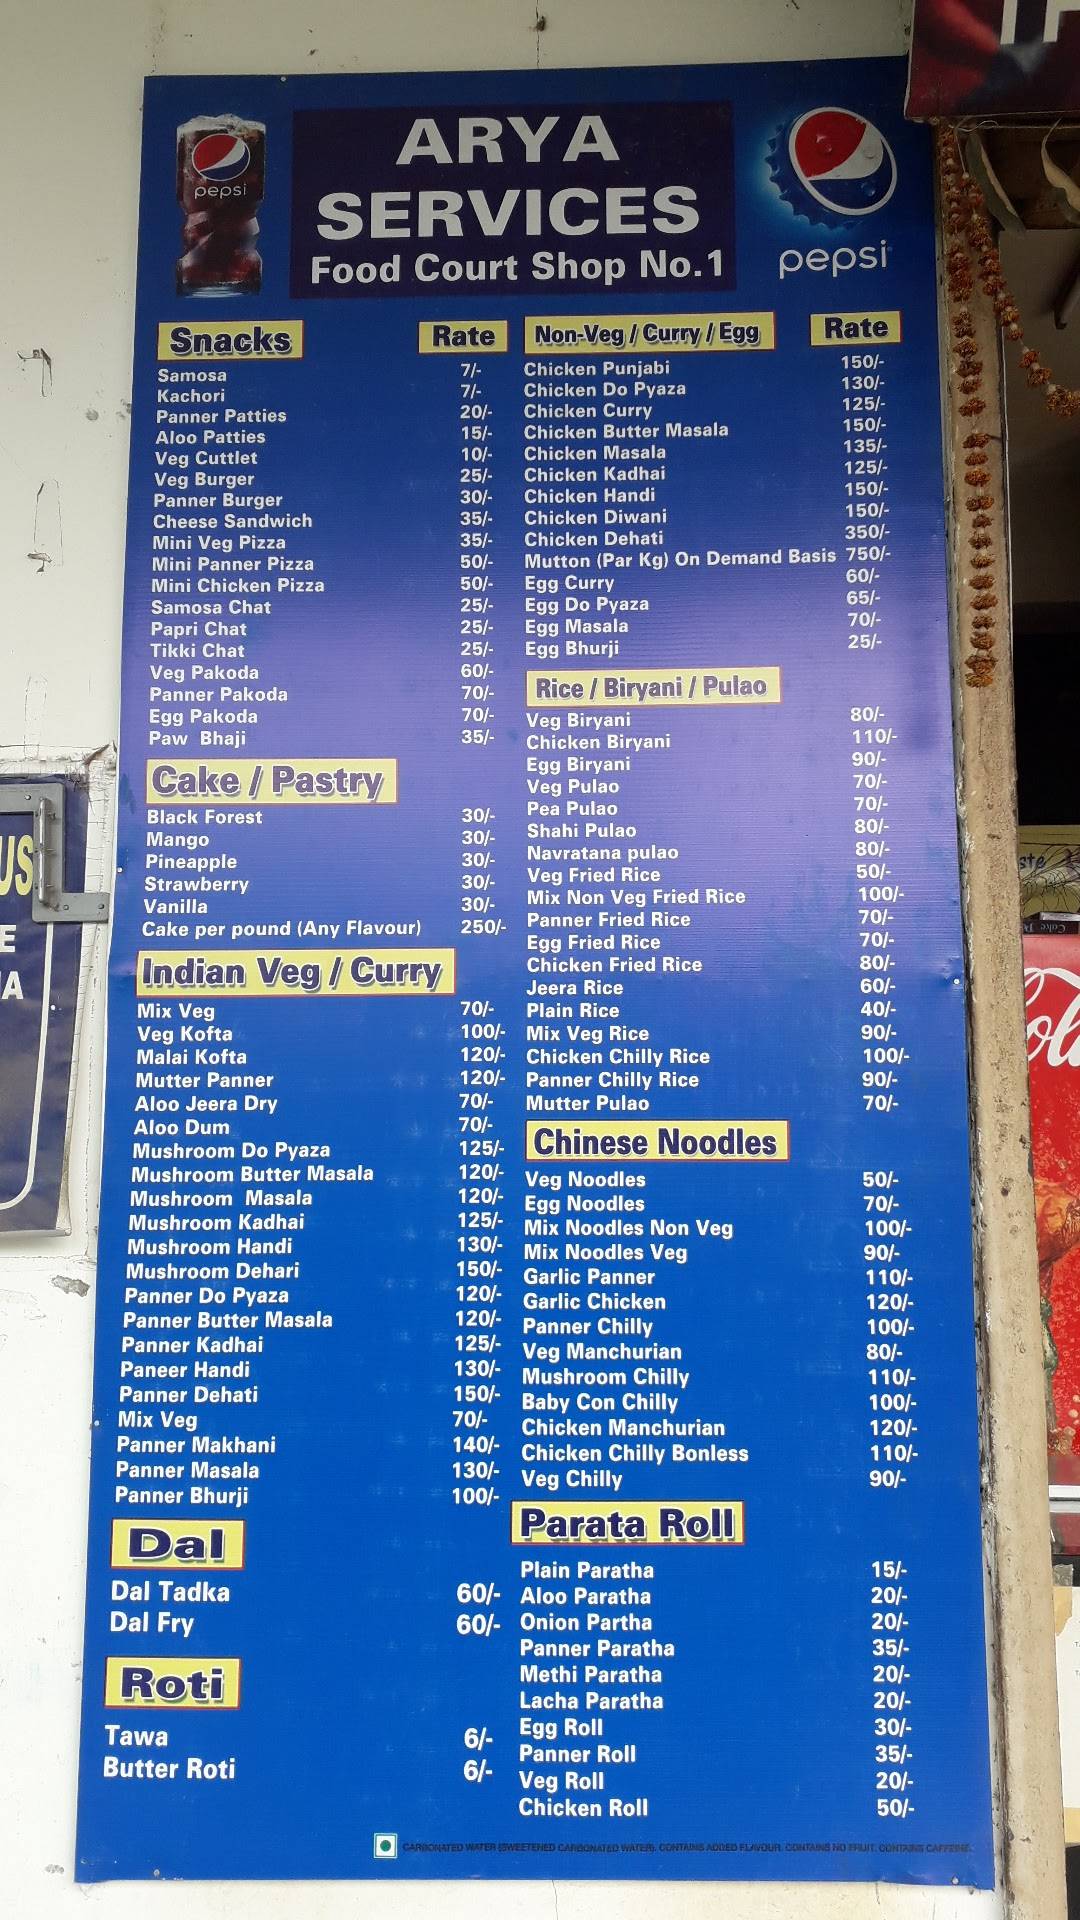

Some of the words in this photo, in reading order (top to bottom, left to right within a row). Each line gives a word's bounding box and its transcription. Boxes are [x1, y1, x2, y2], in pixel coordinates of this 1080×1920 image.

[396, 115, 620, 165] ARYA
[194, 183, 247, 199] pepsi
[317, 185, 700, 240] SERVICES
[312, 256, 400, 284] Food
[415, 253, 518, 282] Court
[532, 251, 625, 286] Shop
[640, 249, 723, 278] No.1
[779, 240, 887, 279] pepsi
[432, 325, 496, 349] Rate
[535, 325, 624, 347] Non-Veg
[643, 322, 700, 346] Curry
[719, 321, 760, 345] Egg
[824, 317, 889, 340] Rate
[170, 326, 292, 354] Snacks
[157, 368, 226, 382] Samosa
[460, 362, 481, 378] 7/-
[155, 430, 196, 444] Aloo
[203, 429, 265, 443] Patties
[461, 425, 492, 441] 15/-
[523, 424, 596, 439] Chicken
[603, 423, 659, 438] Butter
[665, 421, 728, 437] Masala
[843, 416, 886, 432] 150/-
[153, 514, 217, 528] Cheese
[224, 512, 312, 528] Sandwich
[460, 510, 492, 526] 35/-
[524, 510, 597, 525] Chicken
[604, 508, 666, 523] Diwani
[845, 502, 889, 518] 150/-
[524, 553, 590, 568] Mutton
[596, 552, 632, 568] (Par
[639, 551, 668, 570] Kg)
[674, 551, 699, 566] On
[706, 549, 781, 565] Demand
[788, 548, 836, 563] Basis
[845, 545, 890, 561] 750/-
[151, 578, 190, 592] Mini
[197, 577, 270, 592] Chicken
[277, 577, 324, 592] Pizza
[460, 575, 493, 591] 50/-
[149, 664, 184, 683] Veg
[191, 664, 258, 679] Pakoda
[460, 663, 493, 679] 60/-
[536, 678, 584, 699] Rice
[604, 676, 682, 702] Biryani
[704, 676, 767, 696] Pulao
[149, 730, 188, 745] Paw
[200, 730, 245, 748] Bhaji
[461, 728, 494, 745] 35/-
[526, 734, 600, 749] Chicken
[607, 733, 670, 751] Biryani
[852, 727, 897, 744] 110/-
[151, 765, 240, 795] Cake
[272, 765, 383, 801] Pastry
[146, 831, 209, 850] Mango
[461, 829, 495, 846] 30/-
[527, 845, 621, 860] Navratana
[627, 844, 678, 863] pulao
[855, 840, 890, 857] 80/-
[141, 920, 188, 936] Cake
[194, 924, 225, 939] per
[231, 920, 290, 939] pound
[297, 920, 340, 938] (Any
[346, 919, 420, 936] Flavour)
[460, 918, 506, 935] 250/-
[142, 958, 246, 986] Indian
[257, 957, 321, 991] Veg
[350, 956, 442, 990] Curry
[0, 971, 24, 1000] A
[526, 1002, 572, 1018] Plain
[579, 1002, 619, 1017] Rice
[860, 1000, 896, 1017] 40/-
[137, 1025, 173, 1045] Veg
[180, 1025, 232, 1041] Kofta
[461, 1023, 505, 1040] 100/-
[526, 1048, 602, 1064] Chicken
[609, 1048, 663, 1067] Chilly
[669, 1048, 710, 1063] Rice
[863, 1047, 909, 1064] 100/-
[134, 1095, 179, 1111] Aloo
[185, 1095, 237, 1111] Jeera
[244, 1094, 277, 1114] Dry
[458, 1092, 493, 1110] 70/-
[533, 1127, 648, 1155] Chinese
[658, 1127, 777, 1156] Noodles
[131, 1166, 233, 1182] Mushroom
[240, 1165, 300, 1181] Butter
[307, 1164, 373, 1181] Masala
[459, 1163, 504, 1181] 120/-
[524, 1194, 560, 1214] Egg
[567, 1194, 644, 1211] Noodles
[863, 1194, 899, 1213] 70/-
[126, 1262, 228, 1279] Mushroom
[236, 1261, 299, 1278] Dehari
[456, 1259, 502, 1278] 150/-
[523, 1292, 580, 1309] Garlic
[587, 1292, 665, 1309] Chicken
[866, 1292, 913, 1311] 120/-
[120, 1360, 187, 1377] Paneer
[194, 1360, 249, 1377] Handi
[454, 1359, 500, 1378] 130/-
[522, 1392, 569, 1414] Baby
[576, 1392, 614, 1410] Con
[622, 1392, 678, 1414] Chilly
[869, 1393, 916, 1412] 100/-
[116, 1460, 184, 1478] Panner
[191, 1461, 259, 1478] Masala
[452, 1460, 499, 1480] 130/-
[521, 1508, 646, 1538] Parata
[660, 1508, 734, 1538] Roll
[128, 1527, 225, 1561] Dal
[520, 1560, 569, 1578] Plain
[577, 1561, 653, 1578] Paratha
[871, 1560, 907, 1579] 15/-
[110, 1610, 148, 1632] Dal
[157, 1611, 194, 1637] Fry
[456, 1613, 500, 1636] 60/-
[520, 1612, 579, 1630] Onion
[587, 1612, 652, 1630] Partha
[871, 1612, 908, 1631] 20/-
[120, 1666, 225, 1700] Roti
[519, 1690, 578, 1709] Lacha
[585, 1691, 663, 1709] Paratha
[873, 1690, 911, 1710] 20/-
[103, 1755, 178, 1778] Butter
[186, 1757, 235, 1779] Roti
[463, 1758, 492, 1782] 6/-
